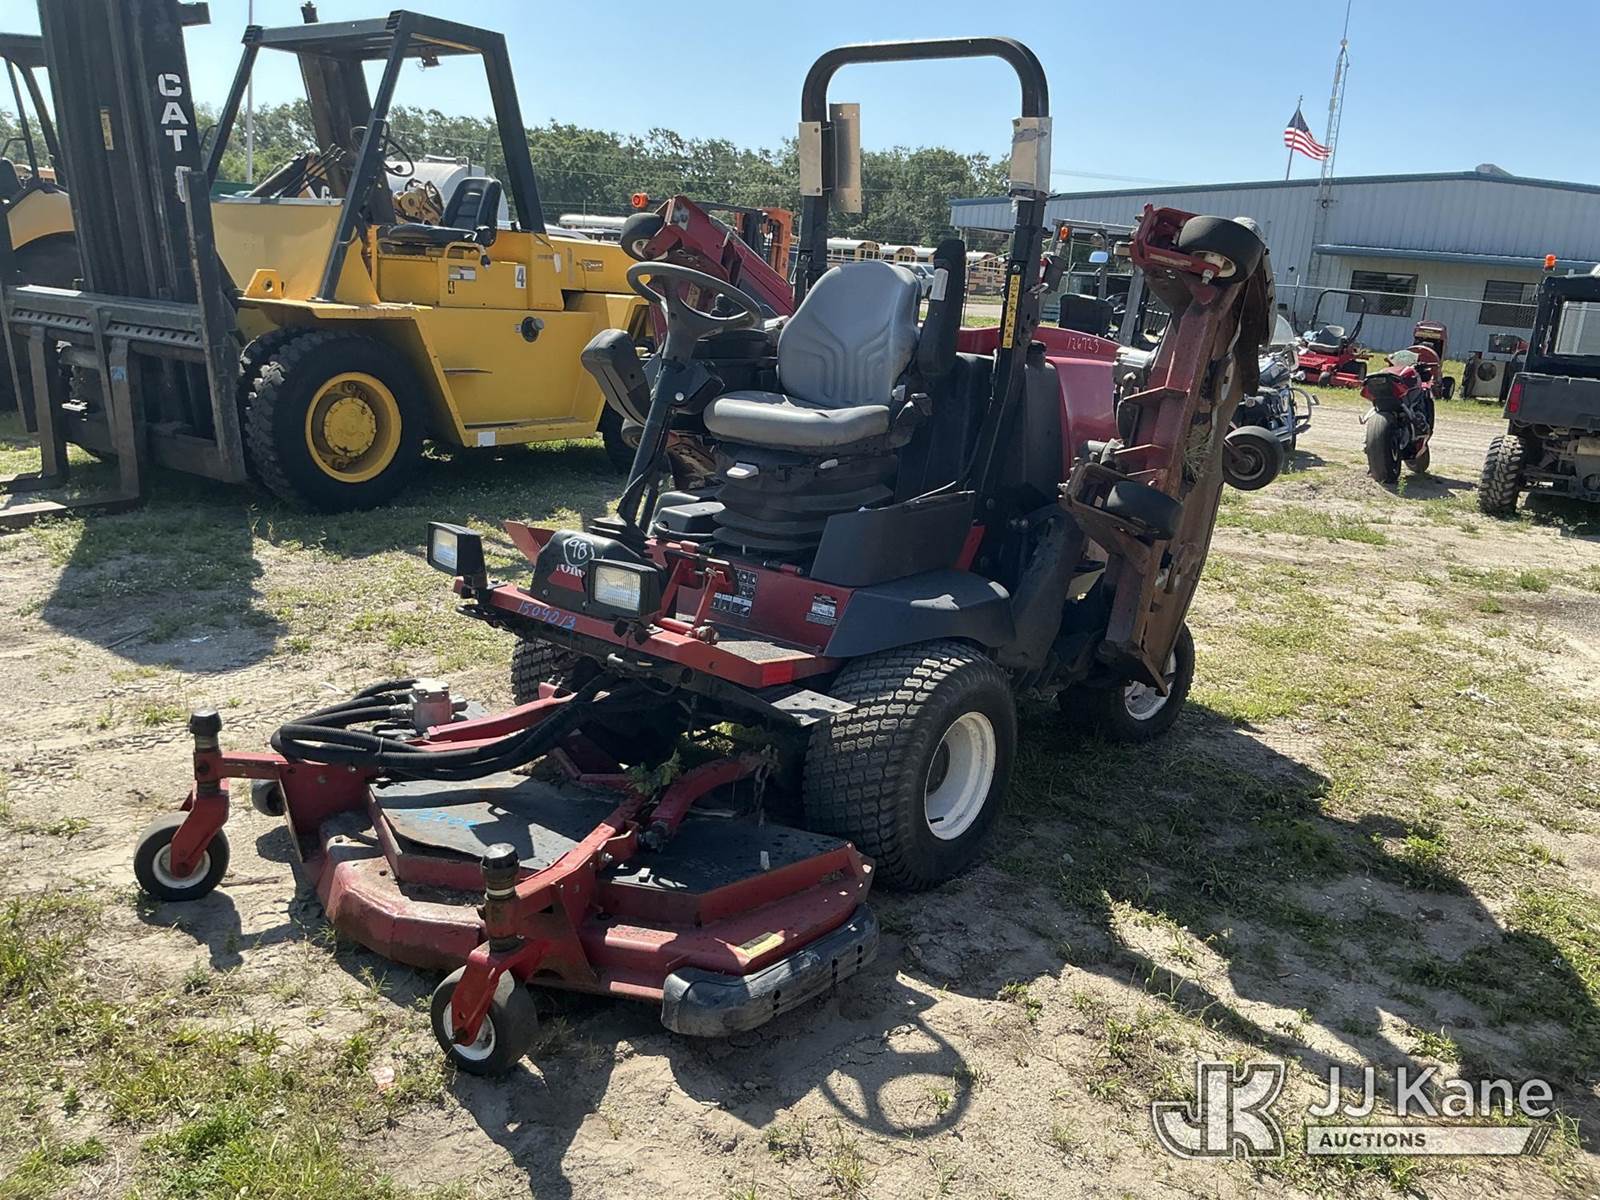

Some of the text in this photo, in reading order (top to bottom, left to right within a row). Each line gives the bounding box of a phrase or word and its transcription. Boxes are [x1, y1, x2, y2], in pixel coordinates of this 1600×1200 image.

[157, 73, 189, 152] CAT
[516, 267, 526, 288] 4
[568, 539, 589, 560] 98
